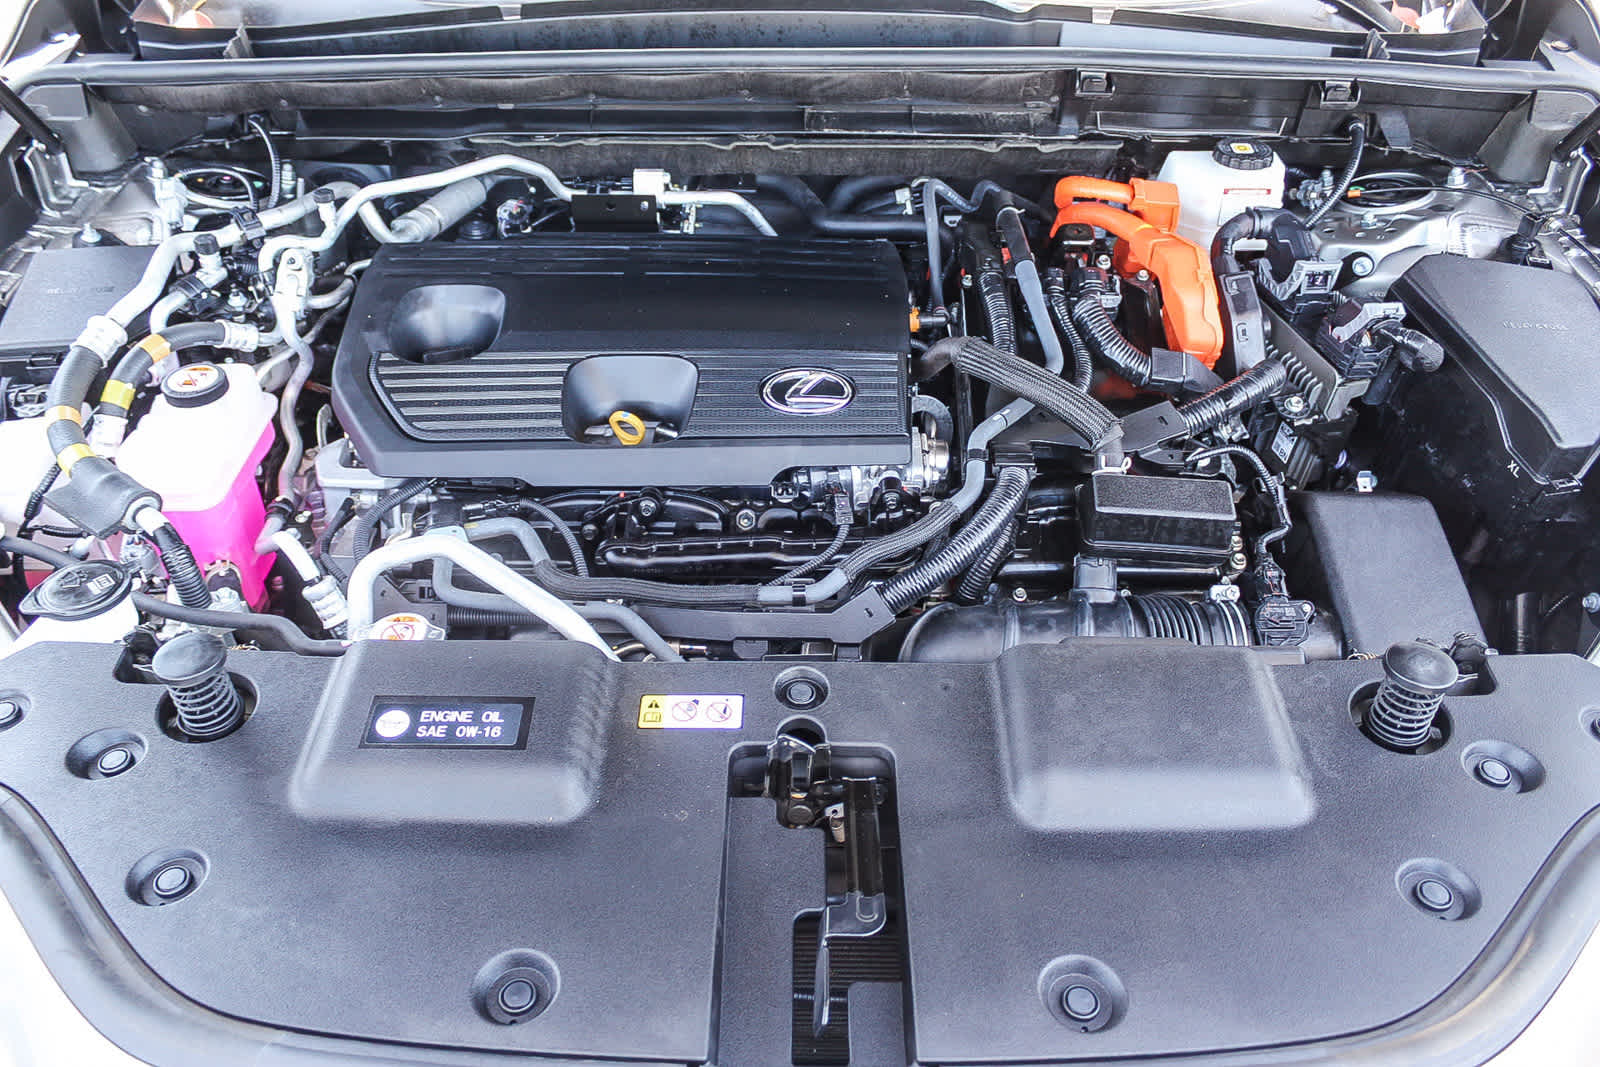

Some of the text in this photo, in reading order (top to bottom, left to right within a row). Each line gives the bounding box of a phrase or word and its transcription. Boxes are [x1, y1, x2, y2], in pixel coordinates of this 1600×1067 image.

[419, 710, 505, 723] ENGINE OIL
[416, 725, 502, 738] SAE 0W-16
